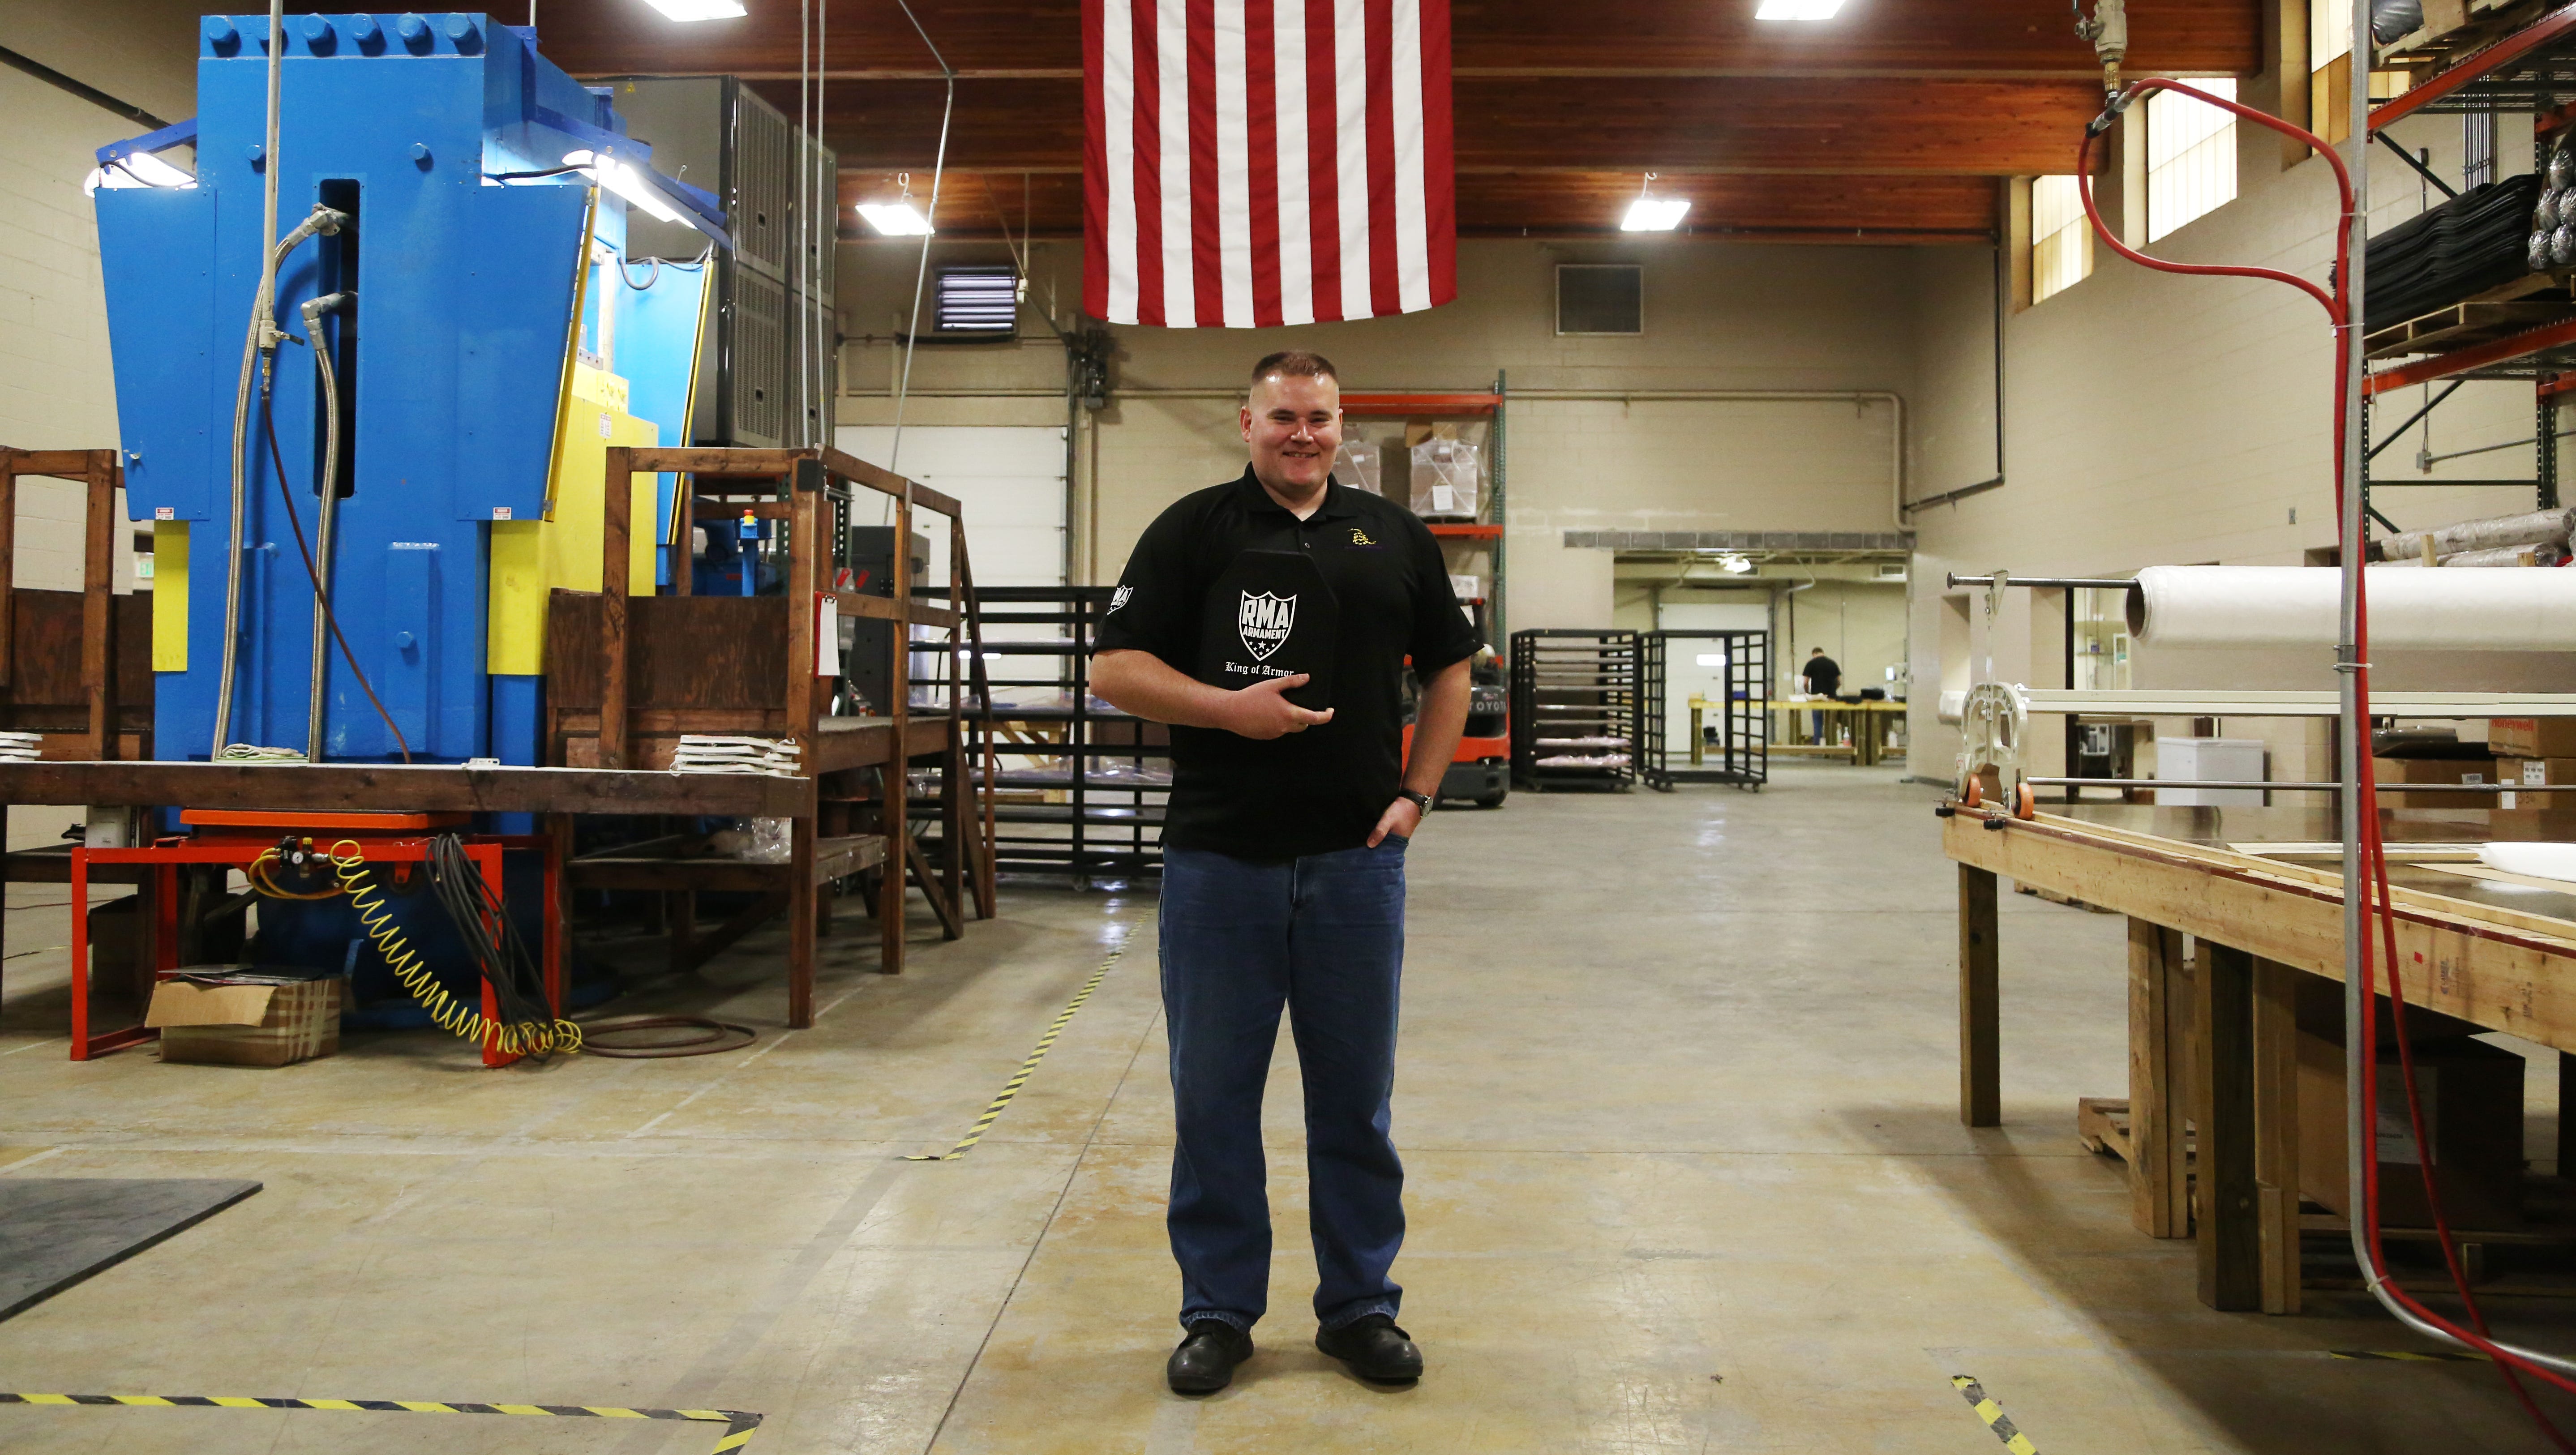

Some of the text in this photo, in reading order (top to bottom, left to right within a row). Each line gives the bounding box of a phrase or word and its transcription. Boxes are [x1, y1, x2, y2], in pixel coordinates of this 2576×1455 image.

[1113, 588, 1129, 602] MA
[1242, 599, 1289, 629] RMA
[1243, 626, 1286, 639] ARMAMENT
[1225, 661, 1294, 677] King of Armor
